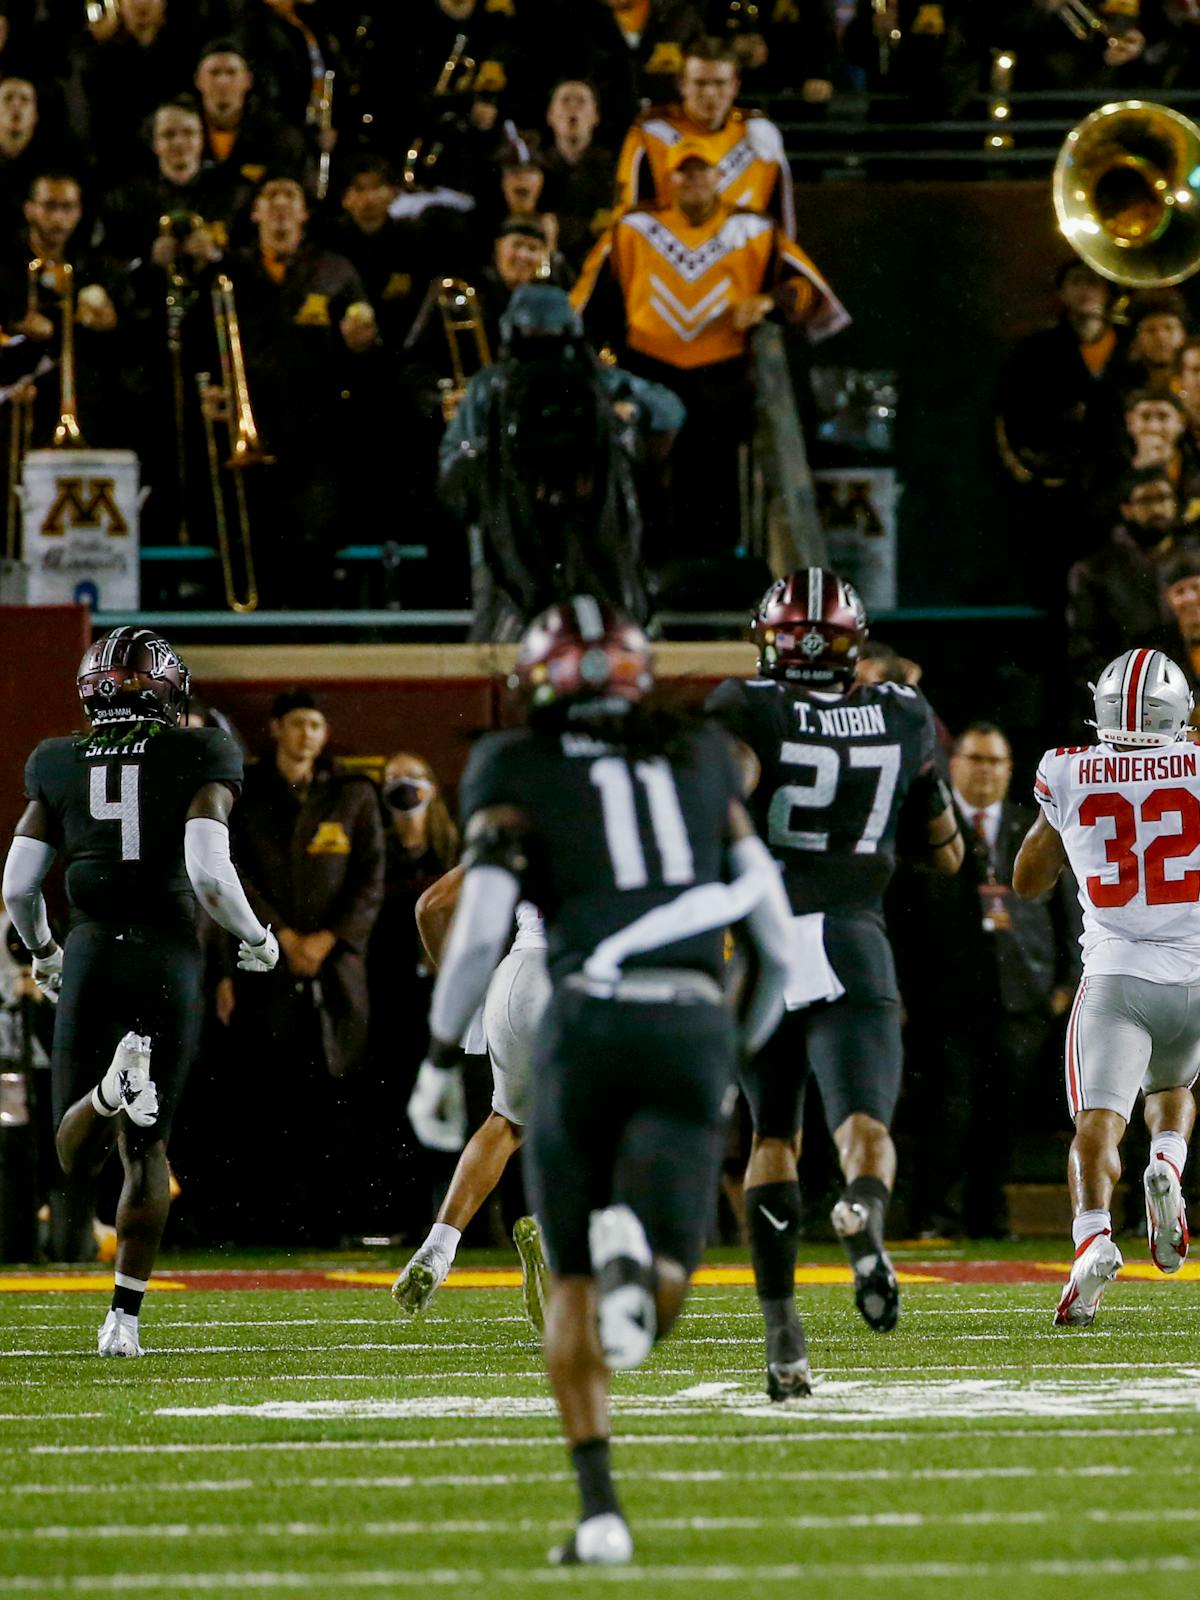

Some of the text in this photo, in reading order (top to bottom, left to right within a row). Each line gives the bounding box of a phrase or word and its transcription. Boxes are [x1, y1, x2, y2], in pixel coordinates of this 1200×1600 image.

[40, 476, 128, 536] M
[793, 701, 886, 737] T. NUBIN
[1104, 734, 1160, 744] BUCKEYES
[768, 741, 901, 854] 27
[1079, 753, 1197, 784] HENDERSON
[89, 764, 140, 861] 4
[589, 756, 695, 890] 11
